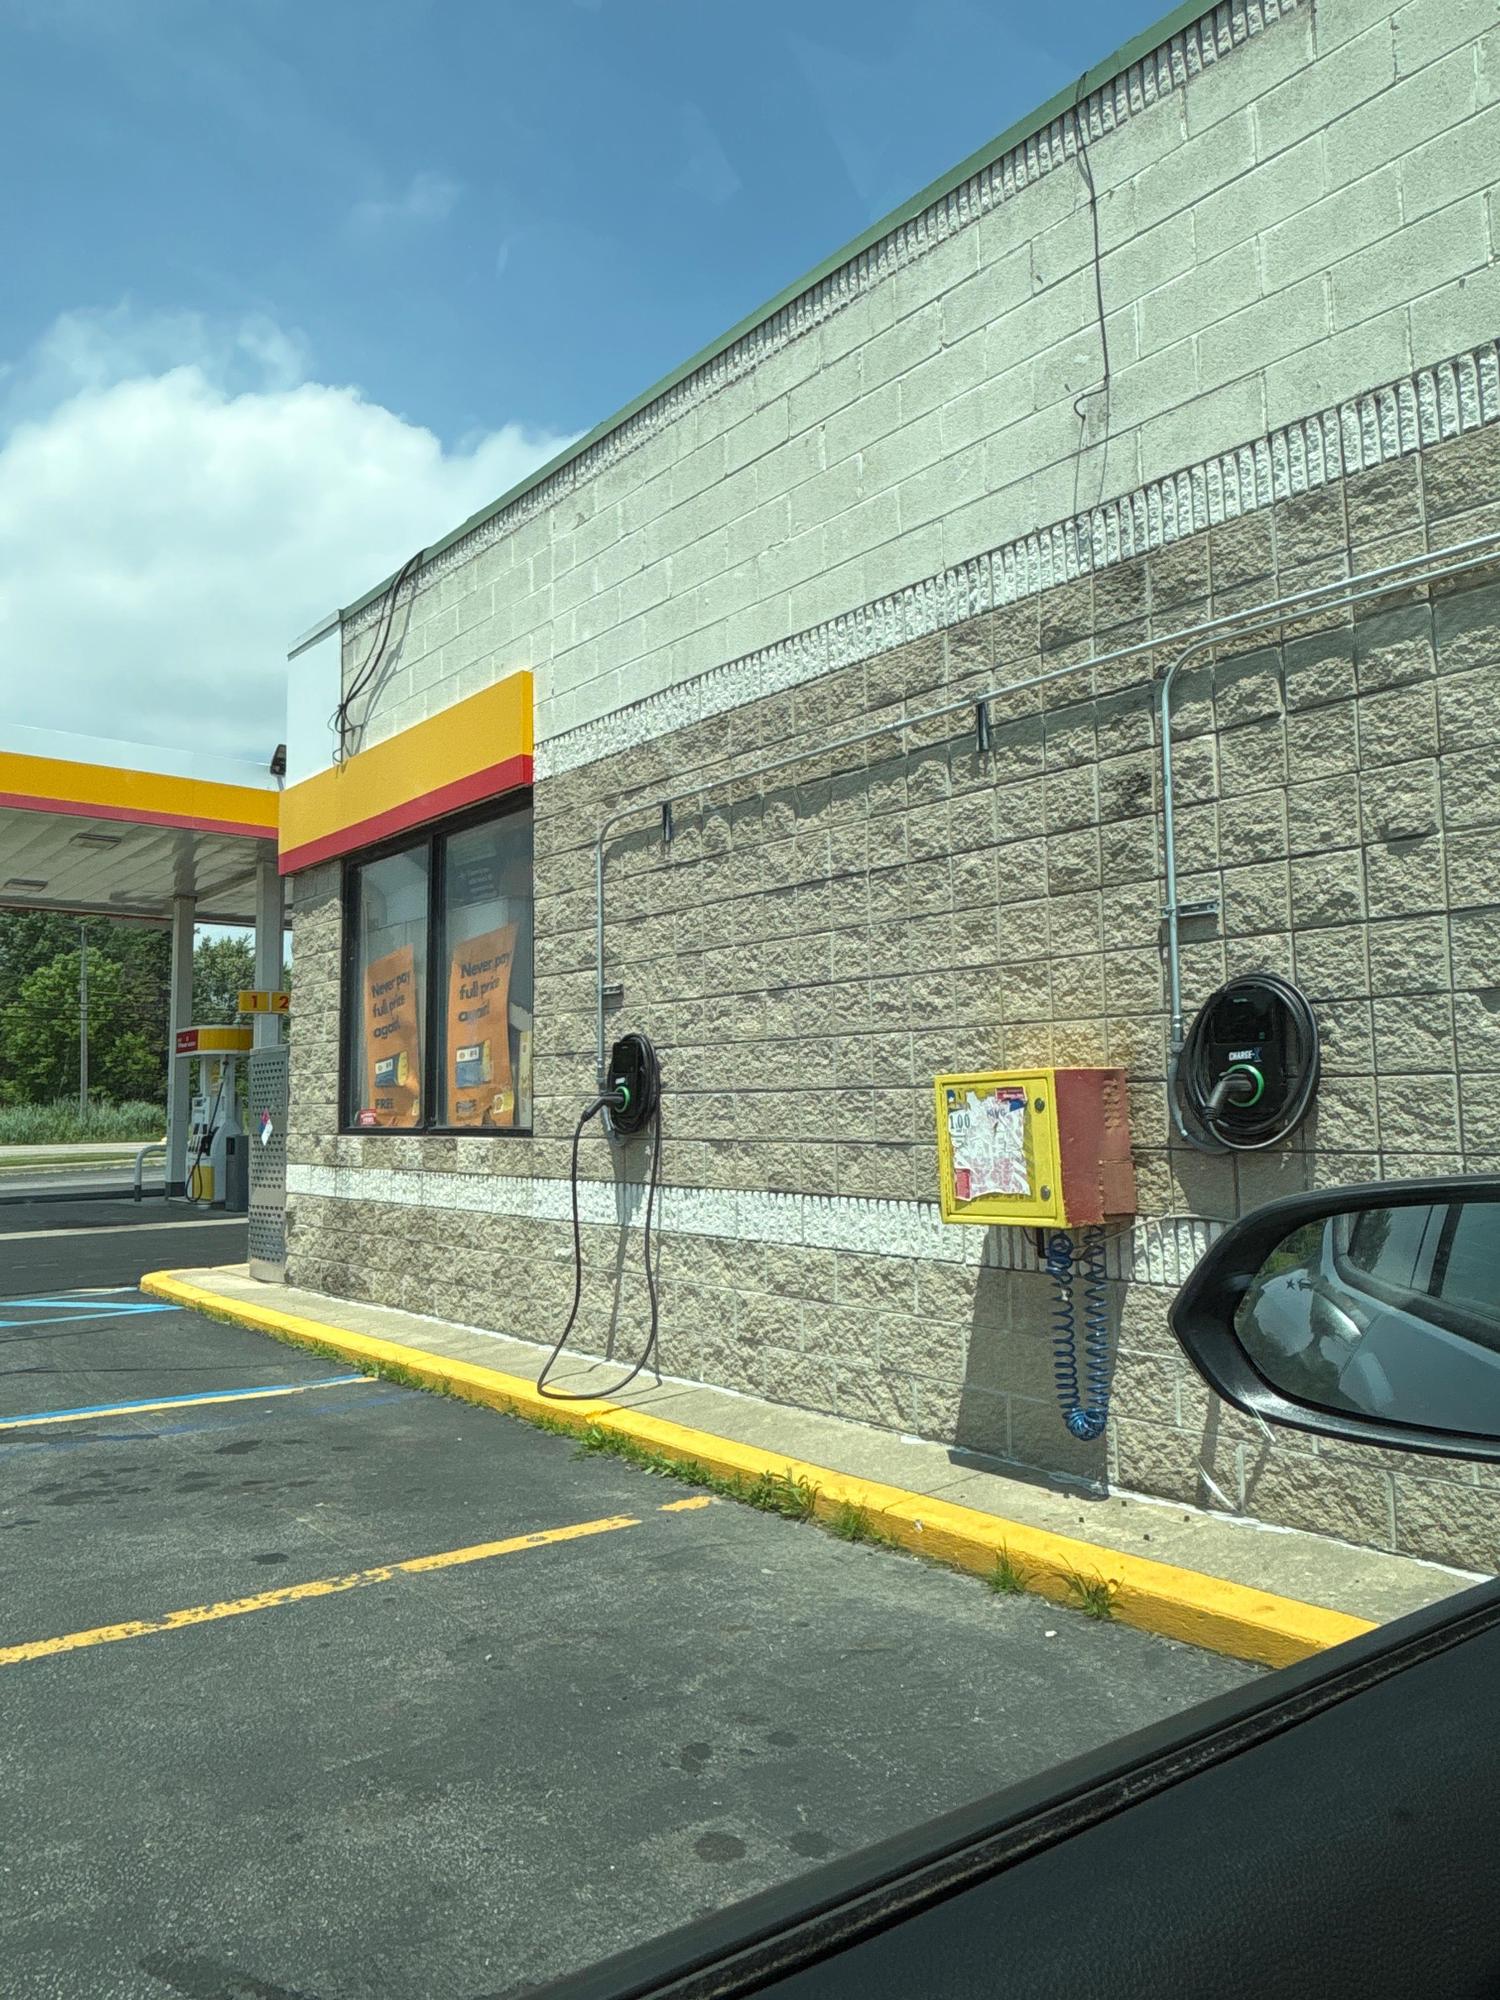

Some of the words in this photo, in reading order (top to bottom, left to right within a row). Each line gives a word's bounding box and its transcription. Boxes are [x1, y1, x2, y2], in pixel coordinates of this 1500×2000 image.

[461, 959, 493, 978] Never
[372, 978, 396, 998] Never
[459, 981, 479, 1001] full
[251, 996, 258, 1008] 1
[279, 996, 289, 1008] 2
[373, 998, 389, 1018] full
[373, 1016, 400, 1040] again
